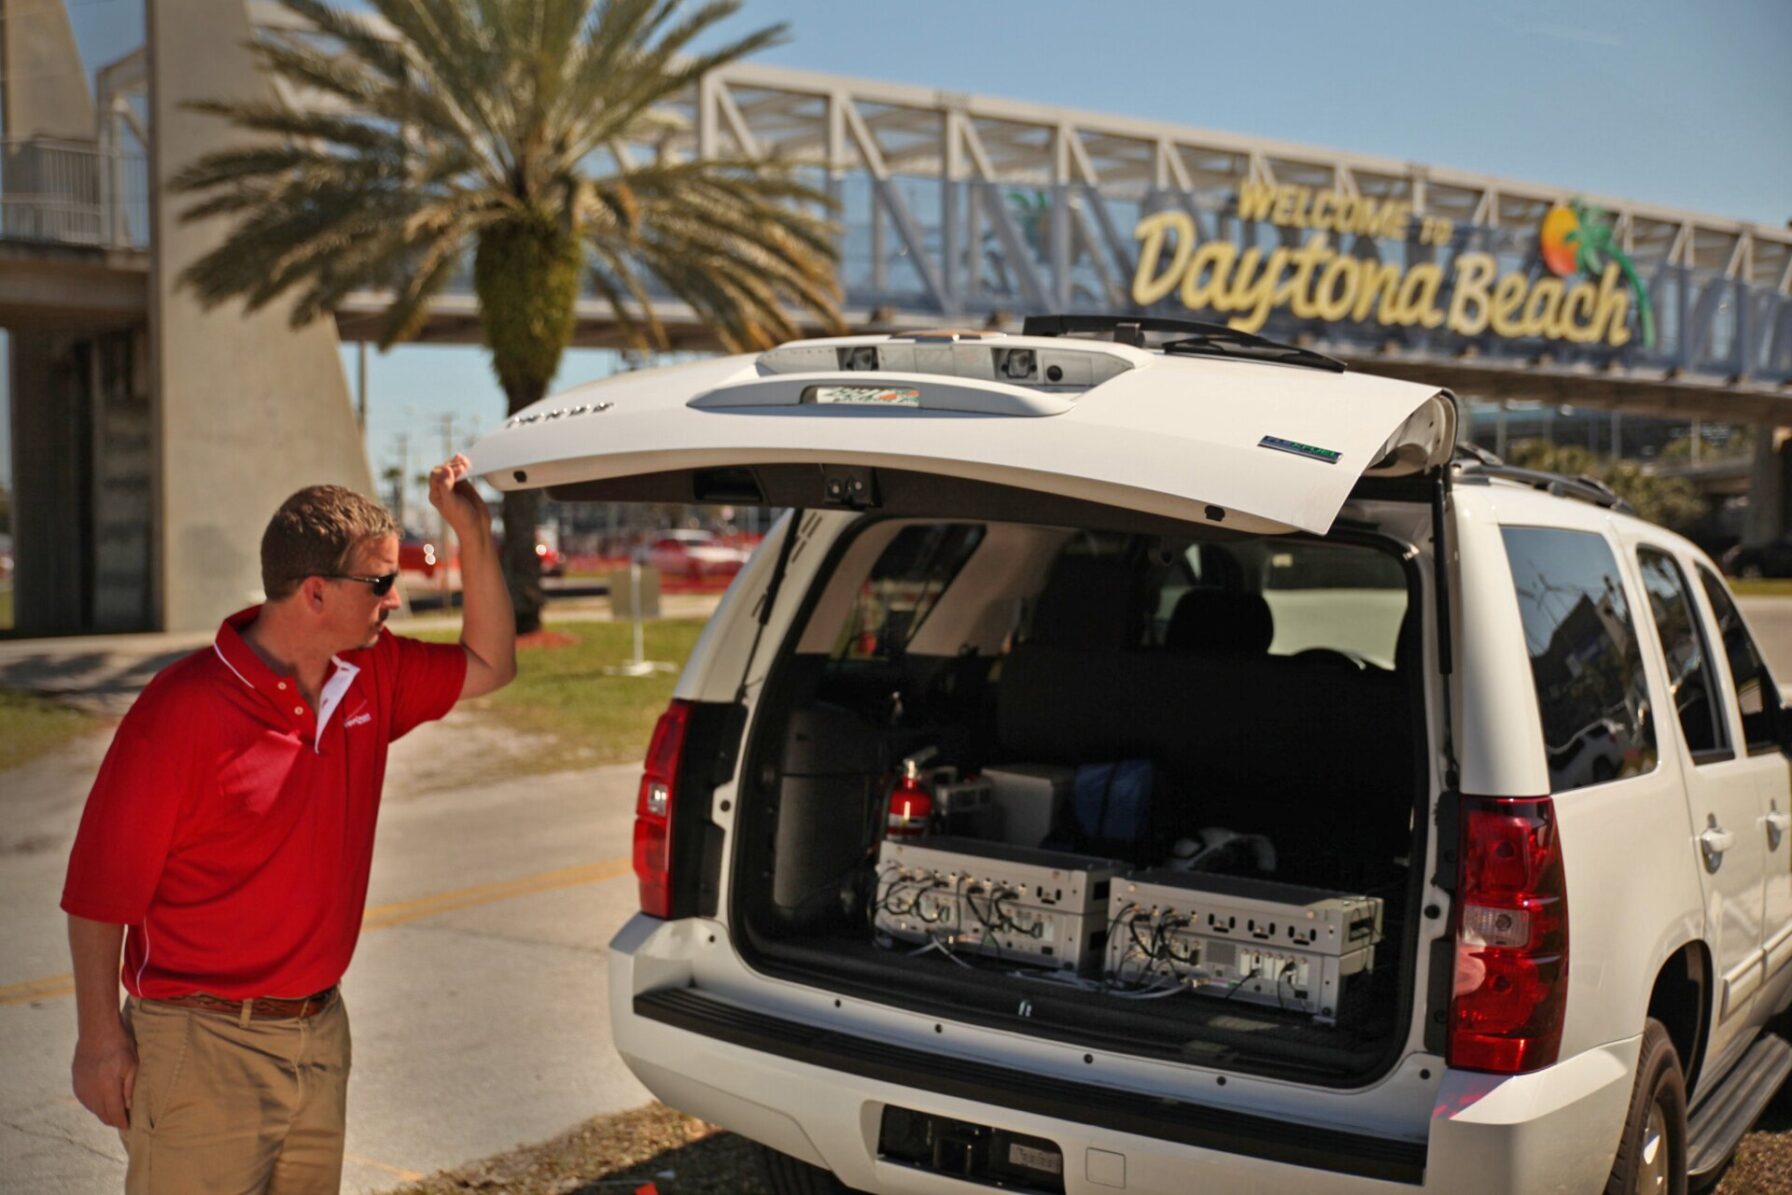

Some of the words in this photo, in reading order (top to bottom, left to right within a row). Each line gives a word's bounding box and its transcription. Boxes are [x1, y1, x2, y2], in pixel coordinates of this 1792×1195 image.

[1238, 180, 1411, 242] WELCOME
[1133, 211, 1444, 334] Daytona
[1447, 252, 1631, 346] Beach
